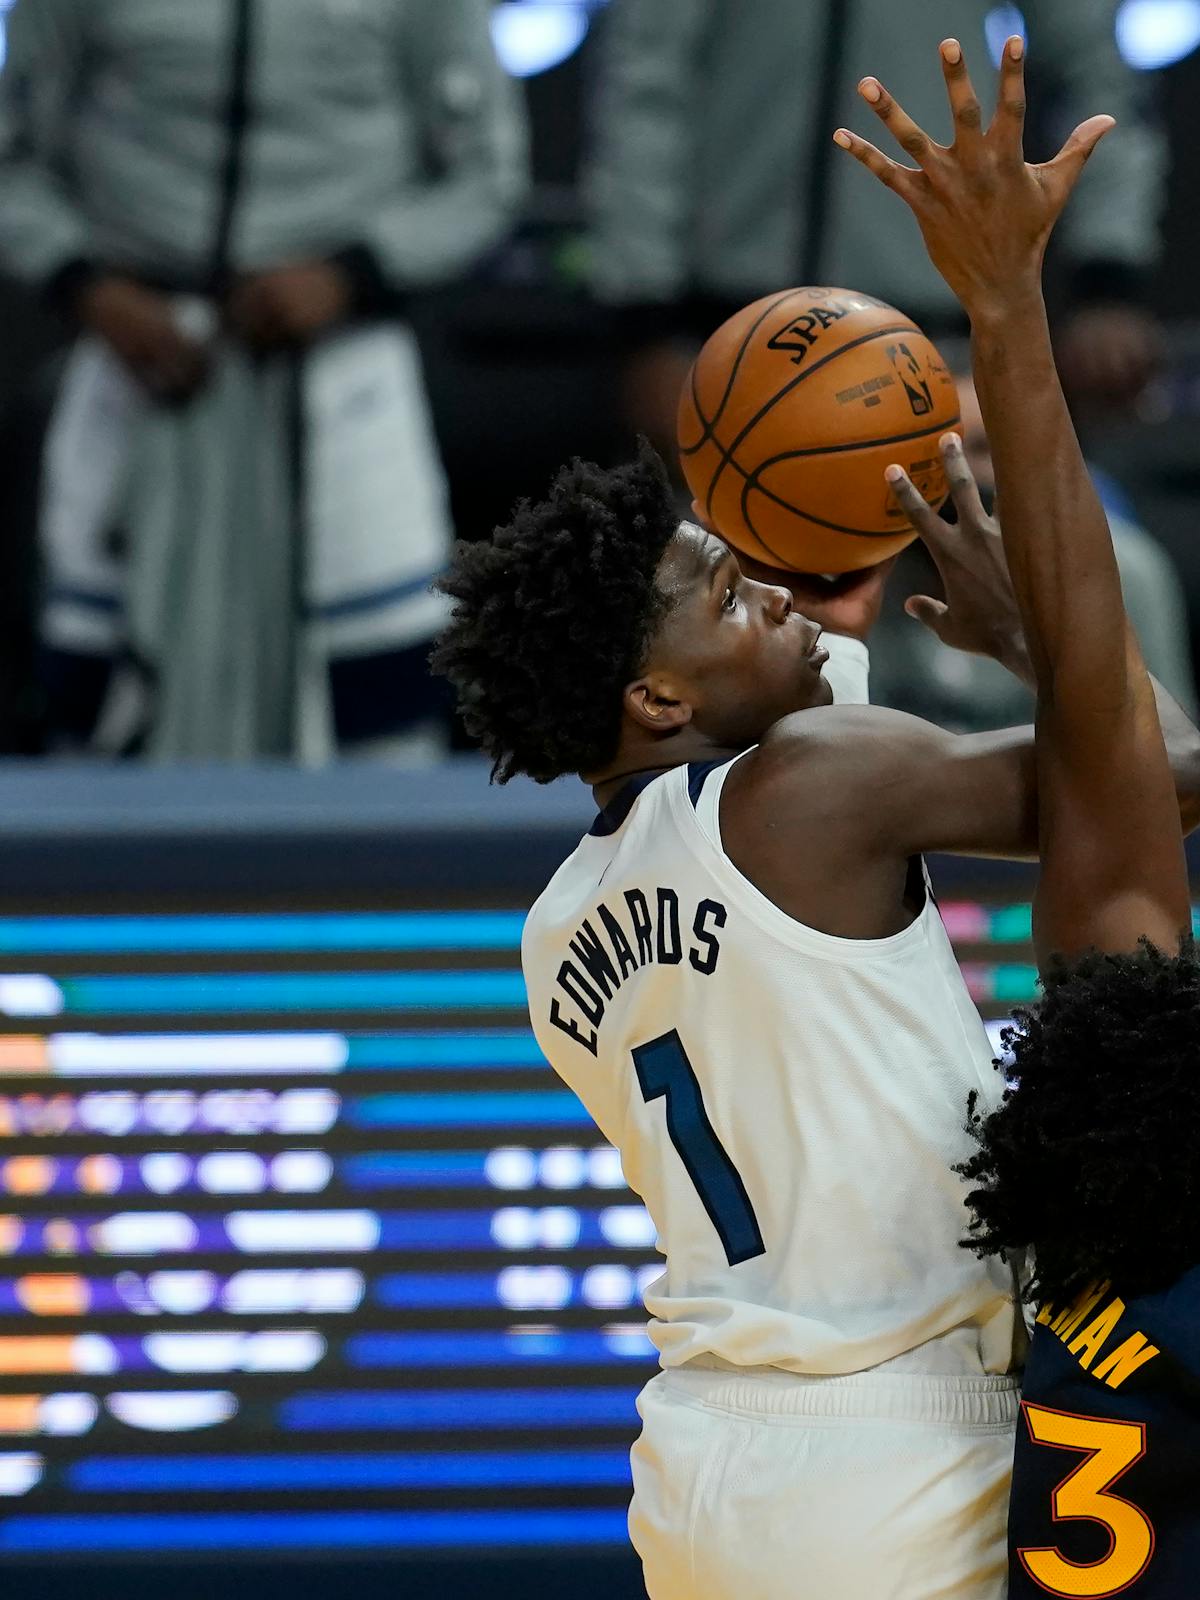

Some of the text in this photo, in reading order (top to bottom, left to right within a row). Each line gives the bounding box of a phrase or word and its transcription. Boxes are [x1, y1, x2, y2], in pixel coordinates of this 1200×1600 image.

[550, 887, 727, 1057] EDWARDS
[631, 1028, 766, 1267] 1
[1036, 1278, 1160, 1389] MAN
[1017, 1400, 1155, 1600] 3
